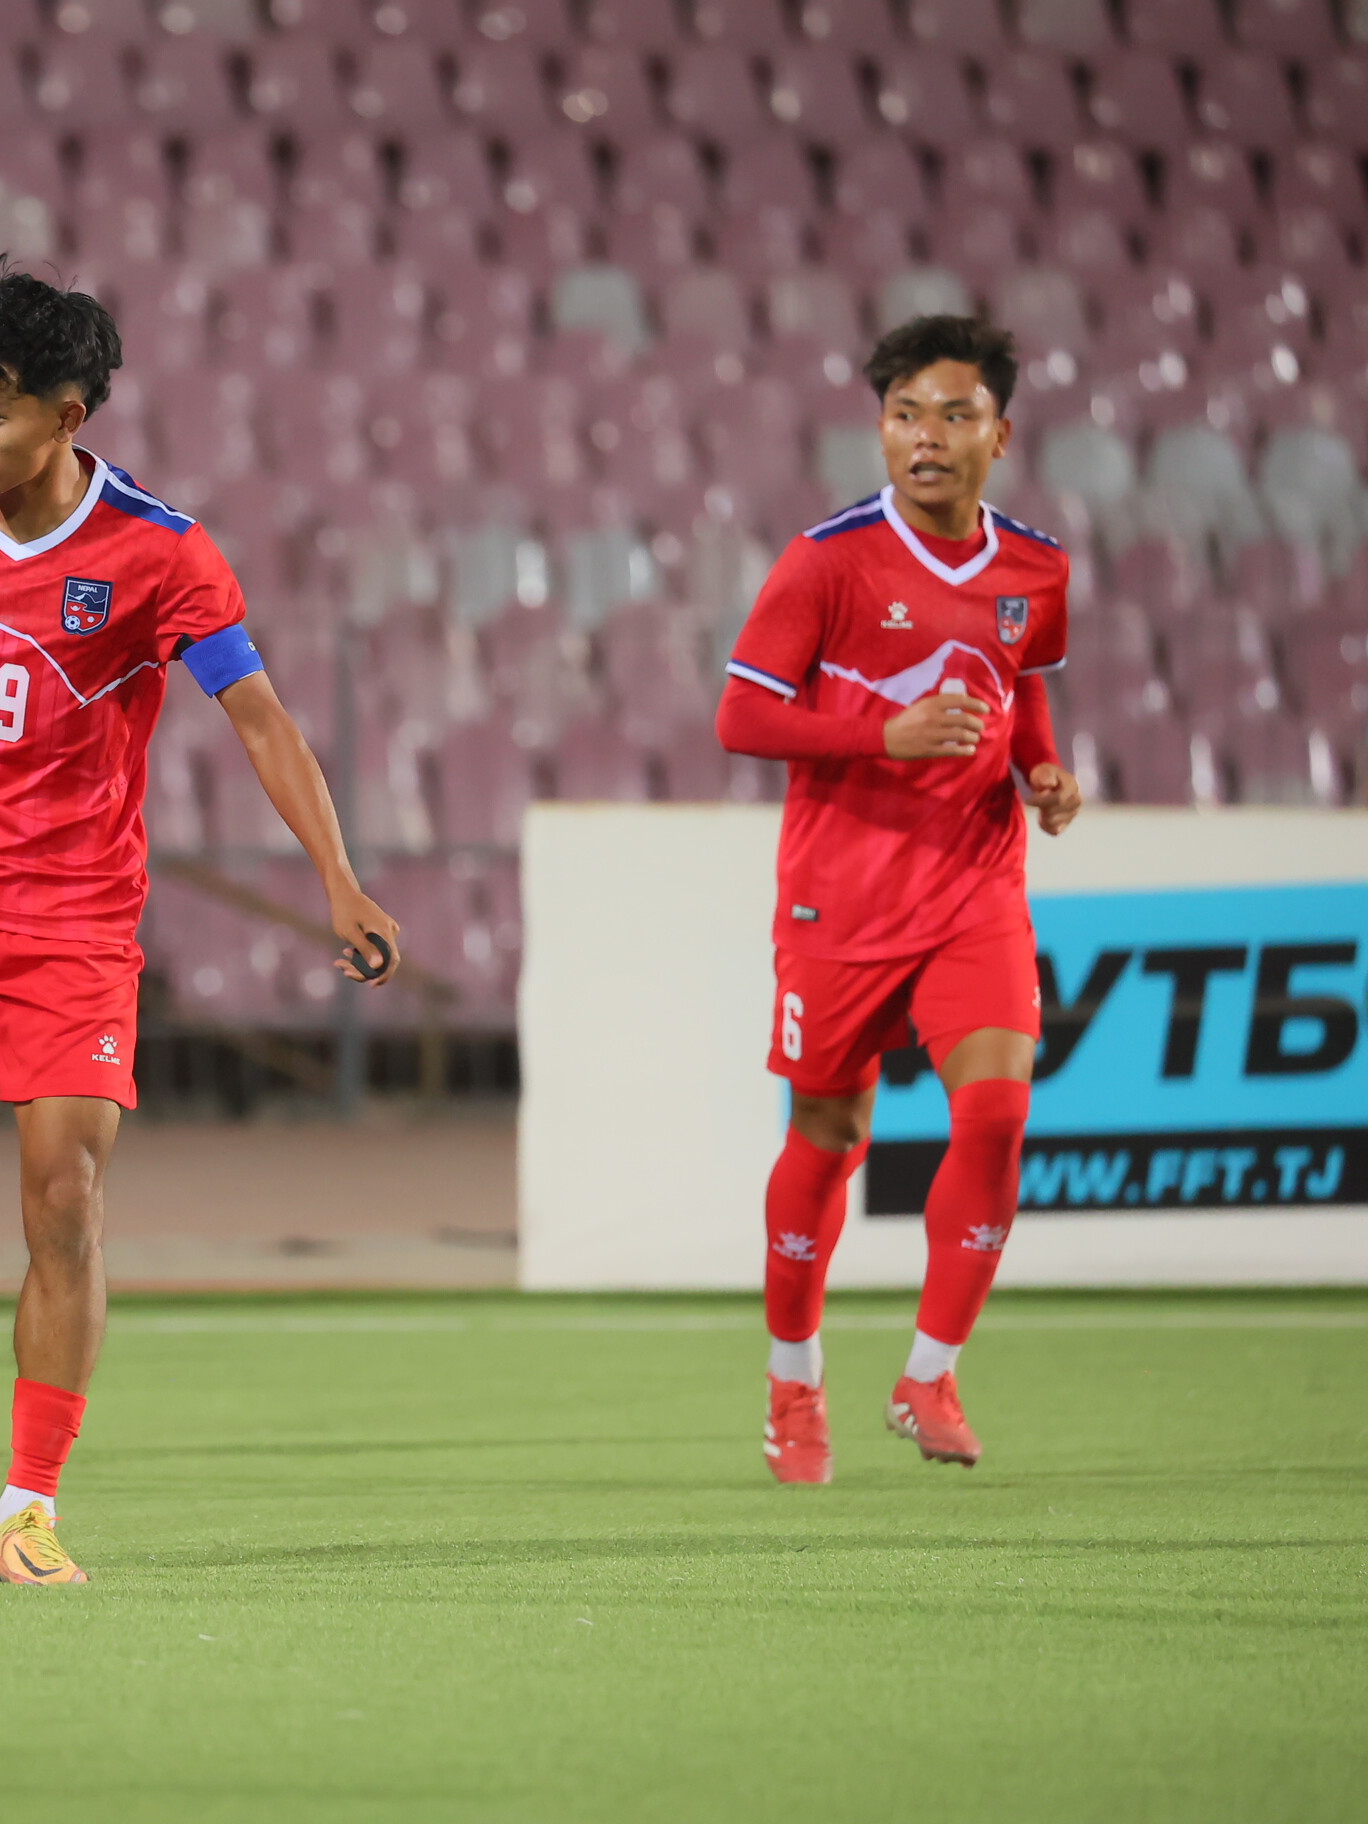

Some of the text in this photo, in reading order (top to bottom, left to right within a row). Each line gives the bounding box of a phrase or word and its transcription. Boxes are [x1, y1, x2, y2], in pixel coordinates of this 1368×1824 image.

[77, 584, 98, 593] NEPAL
[782, 991, 805, 1061] 6
[881, 942, 1368, 1085] УТБ
[91, 1053, 121, 1065] KELME
[1018, 1147, 1346, 1204] WW.FFT.TJ
